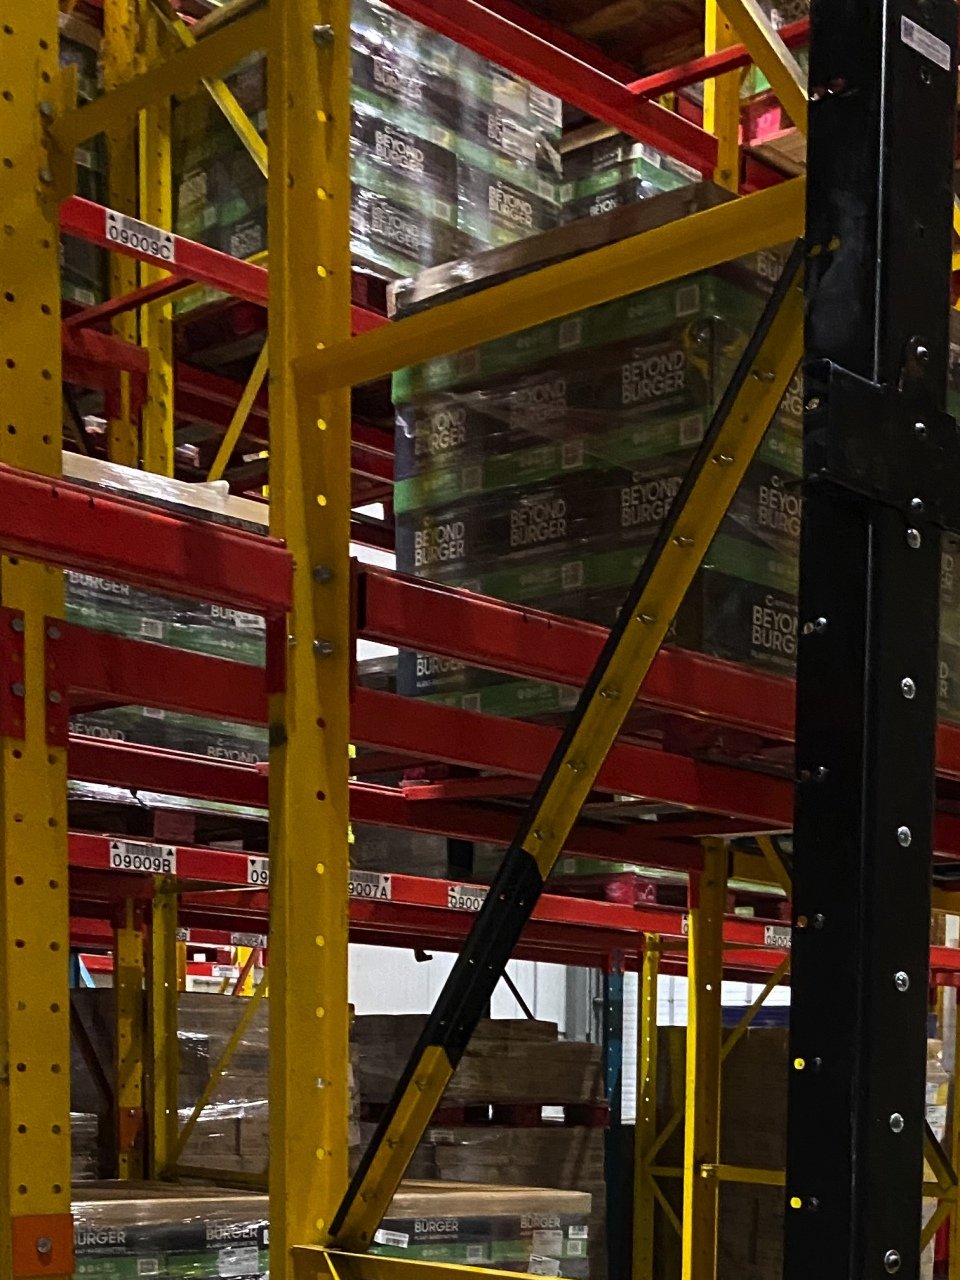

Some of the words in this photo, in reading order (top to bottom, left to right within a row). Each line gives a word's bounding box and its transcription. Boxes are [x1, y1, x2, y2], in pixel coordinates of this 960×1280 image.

[109, 225, 171, 260] 09009C
[622, 351, 685, 385] BEYOND
[622, 369, 685, 404] BURGER
[510, 499, 566, 529] BEYOND
[759, 486, 802, 514] BEYO
[415, 522, 465, 548] BEYOND
[510, 518, 566, 547] BURGER
[759, 506, 800, 536] BURG
[415, 539, 464, 566] BURGER
[753, 606, 798, 634] BEYO
[752, 625, 796, 654] BURG
[113, 853, 171, 873] 09009B
[349, 882, 387, 899] 9007A
[74, 1232, 126, 1246] URGER
[415, 1219, 458, 1233] BURGER
